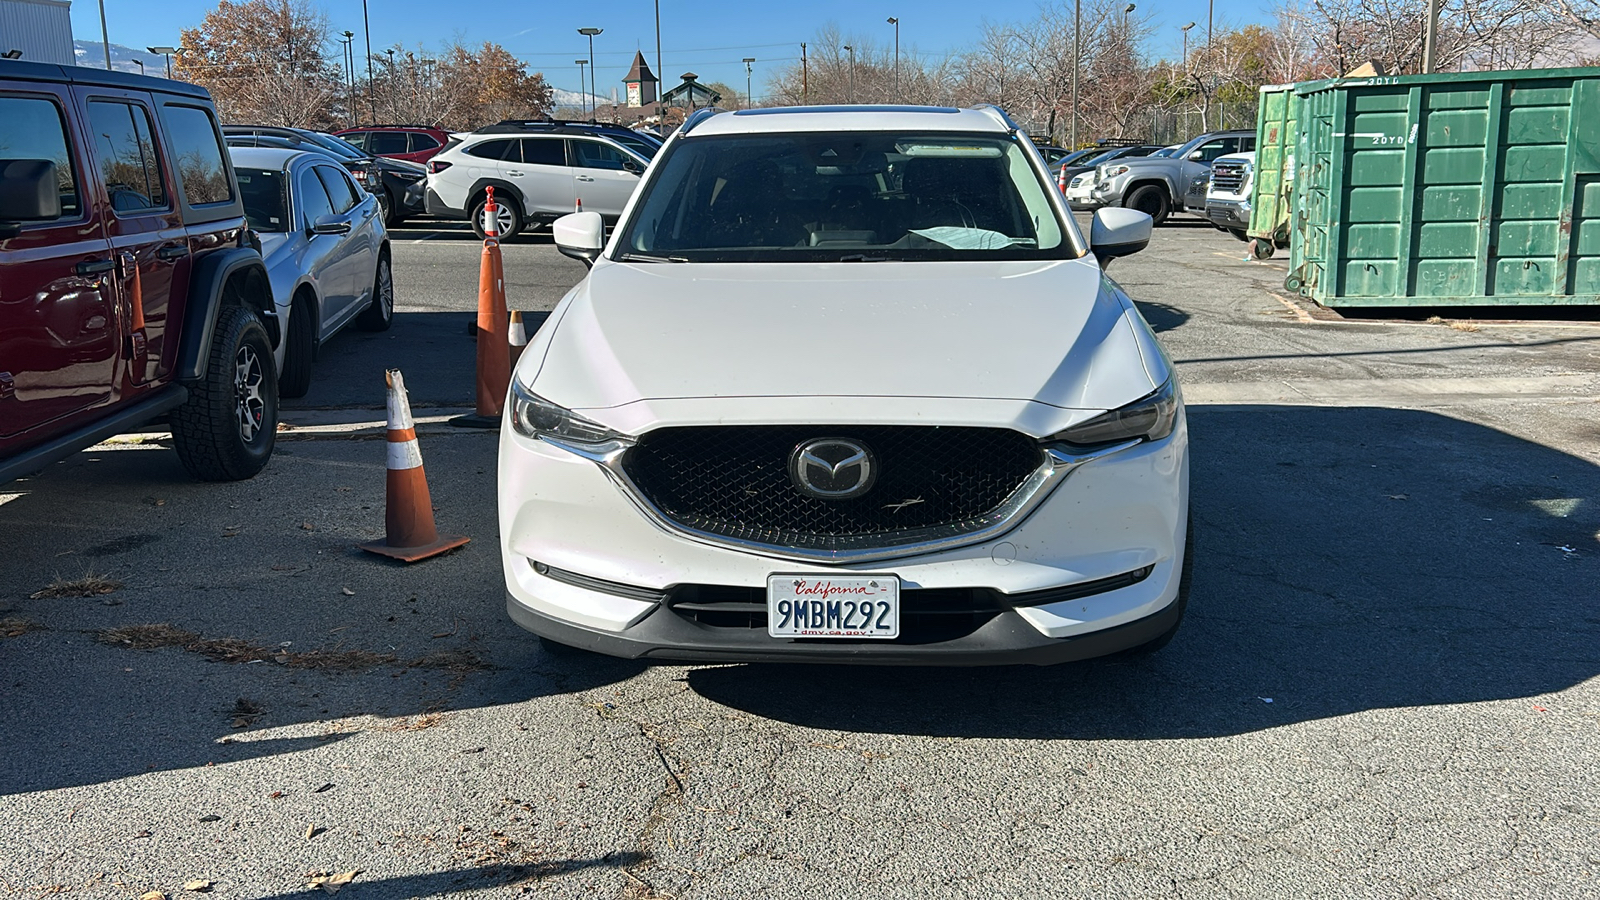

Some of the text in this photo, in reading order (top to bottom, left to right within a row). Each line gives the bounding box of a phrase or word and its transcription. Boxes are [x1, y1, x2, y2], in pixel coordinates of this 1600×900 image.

[1372, 136, 1404, 145] 20YD
[795, 580, 875, 599] California
[777, 600, 891, 630] 9MBM292
